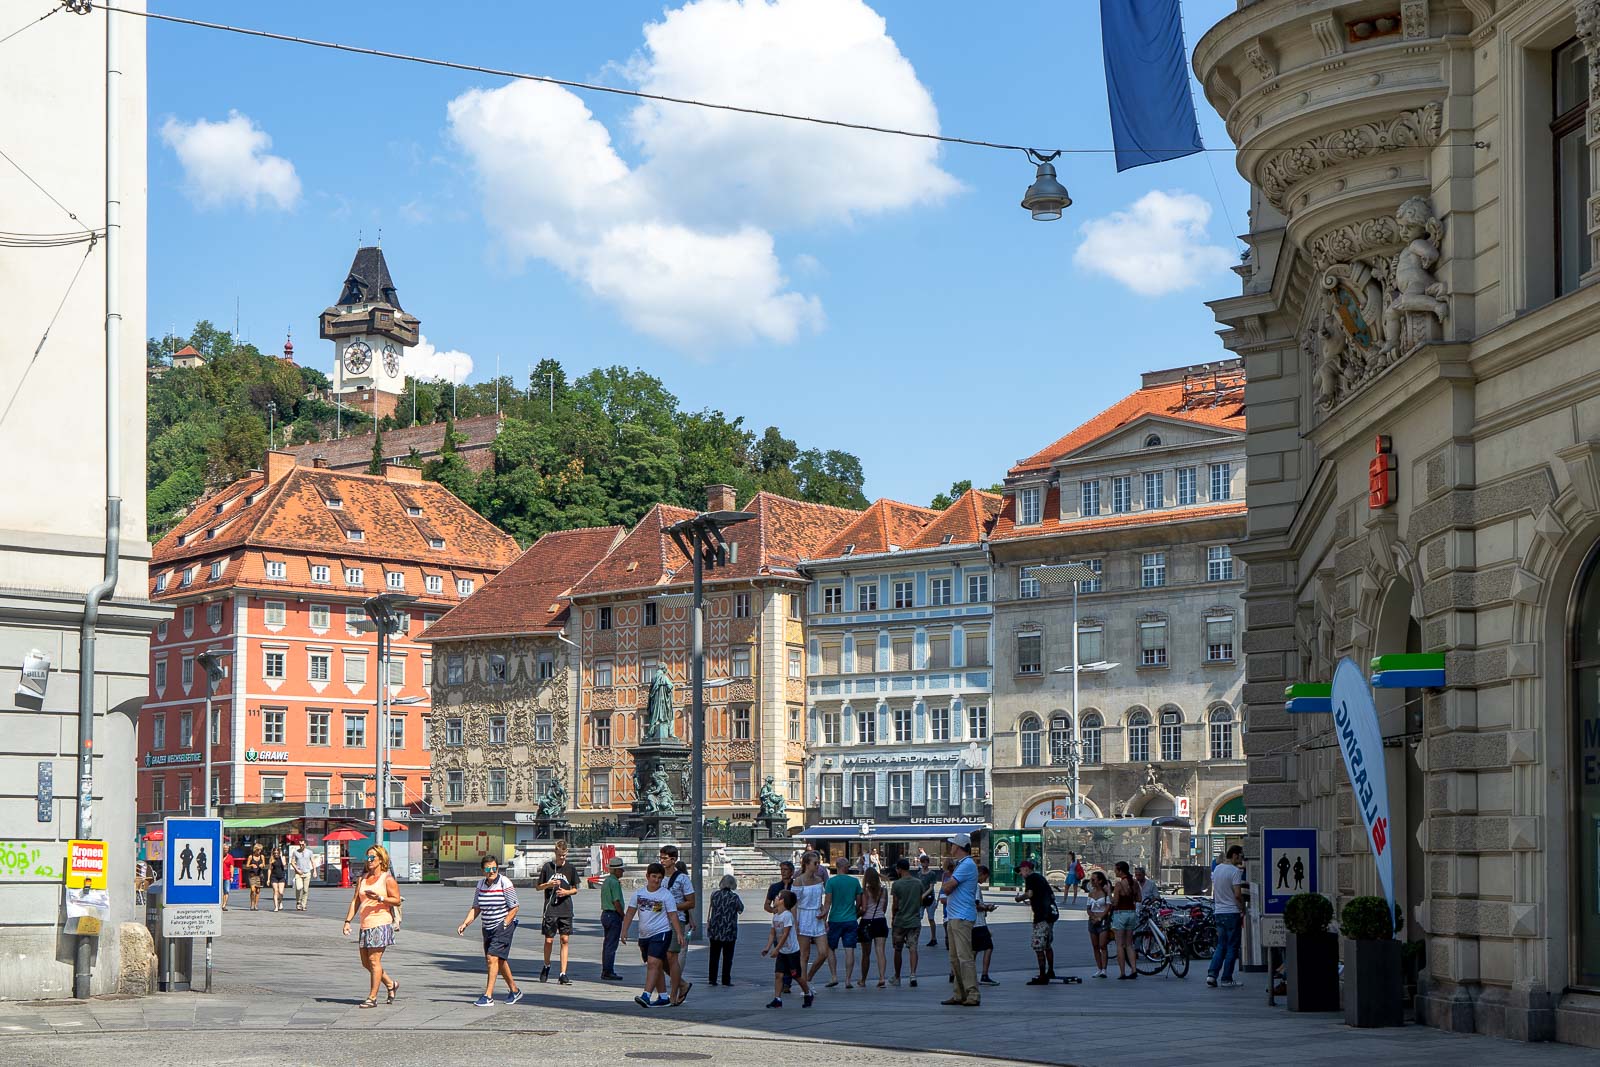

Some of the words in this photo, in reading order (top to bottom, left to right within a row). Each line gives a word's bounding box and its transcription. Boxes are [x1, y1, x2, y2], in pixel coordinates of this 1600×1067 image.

[259, 751, 289, 761] GRAWE
[321, 806, 327, 815] 7
[400, 810, 408, 818] 12
[732, 812, 751, 820] LUSH
[1218, 814, 1236, 824] THE
[72, 846, 103, 857] Kronen
[72, 857, 103, 870] Zeitung
